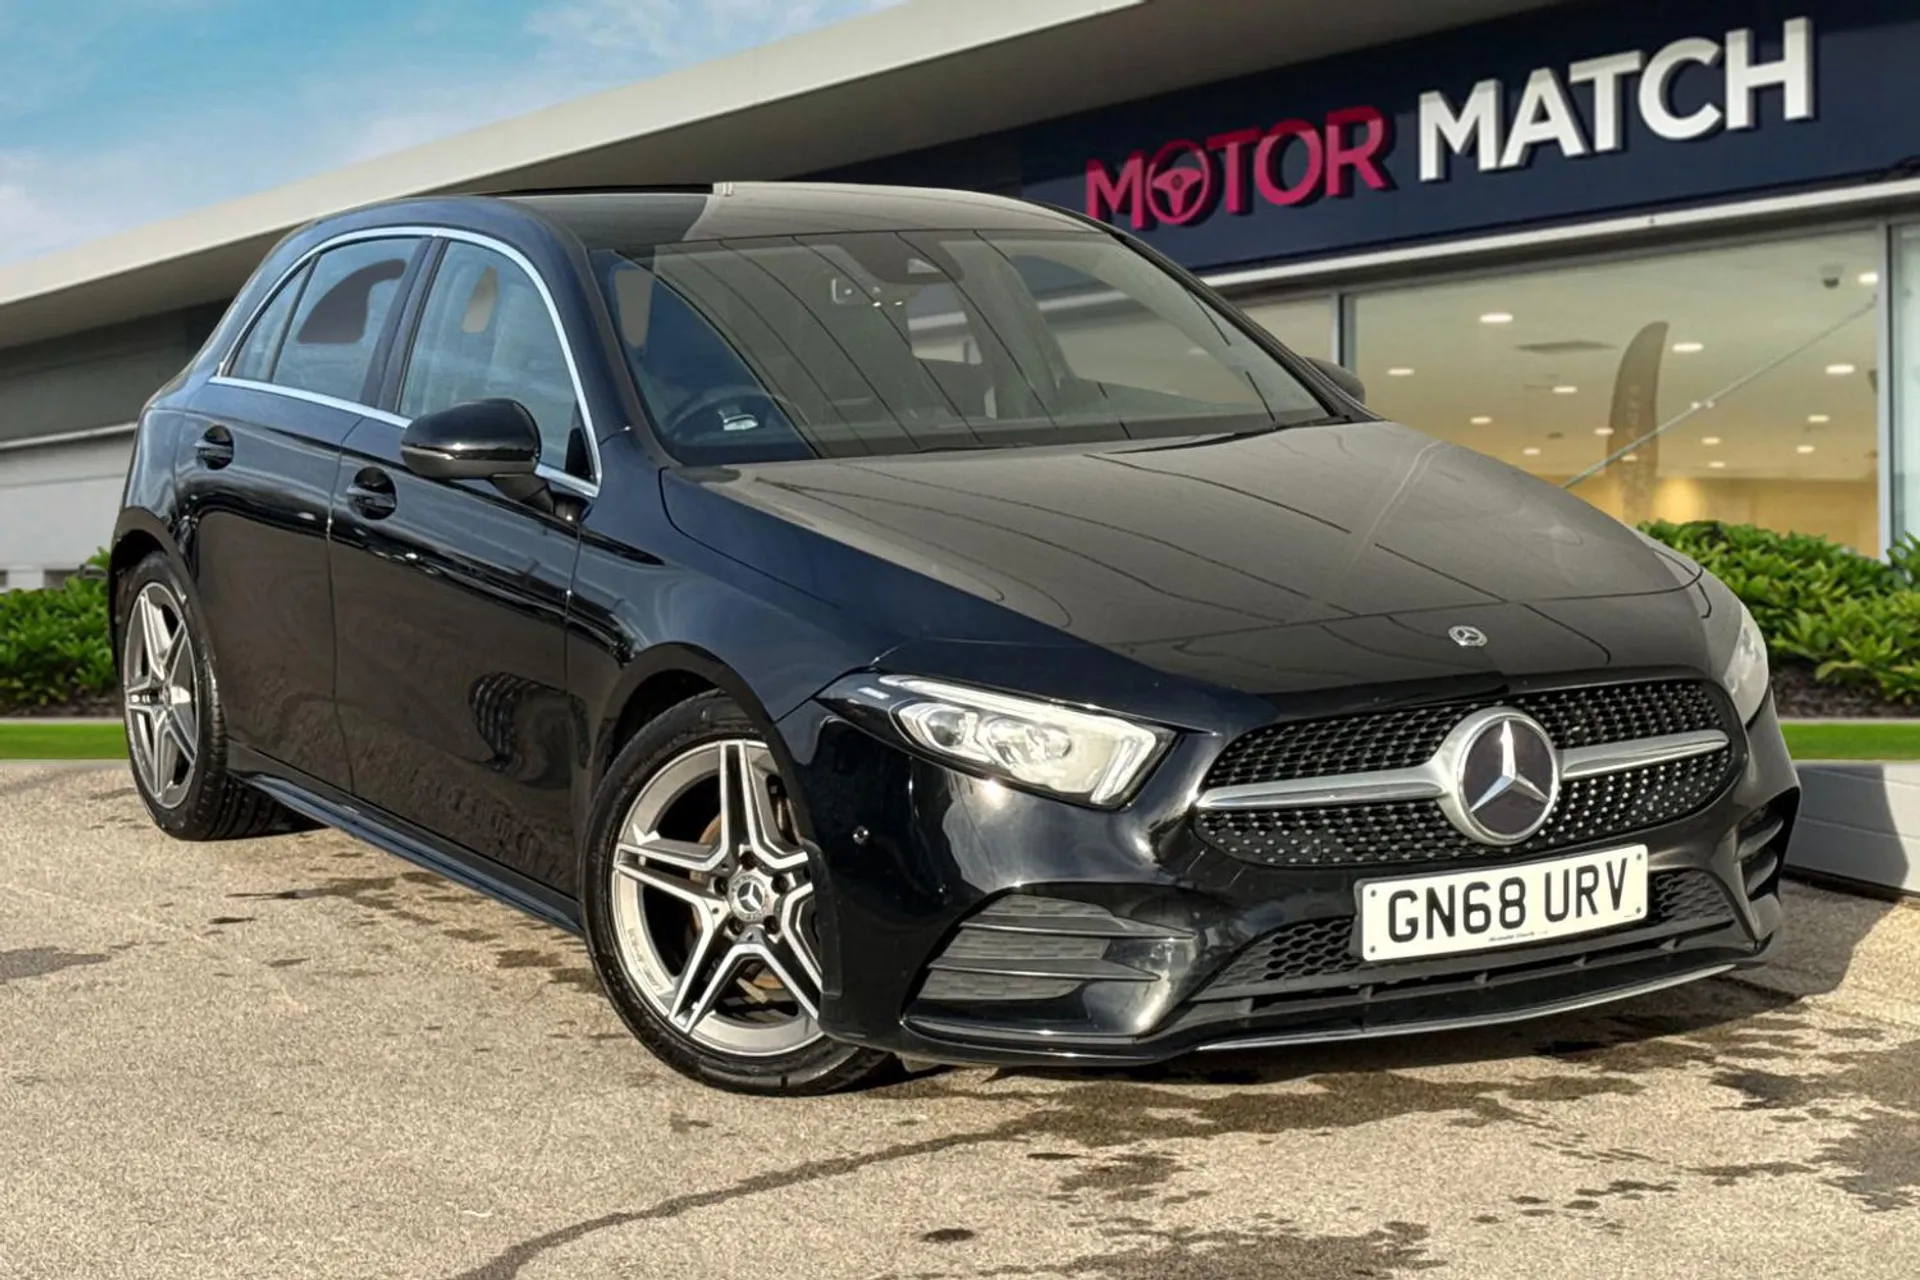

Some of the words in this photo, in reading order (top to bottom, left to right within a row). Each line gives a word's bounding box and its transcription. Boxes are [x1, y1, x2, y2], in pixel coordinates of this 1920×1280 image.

[1085, 105, 1387, 229] MOTOR
[1418, 17, 1812, 181] MATCH
[1388, 876, 1527, 943] GN68
[1544, 857, 1628, 923] URV
